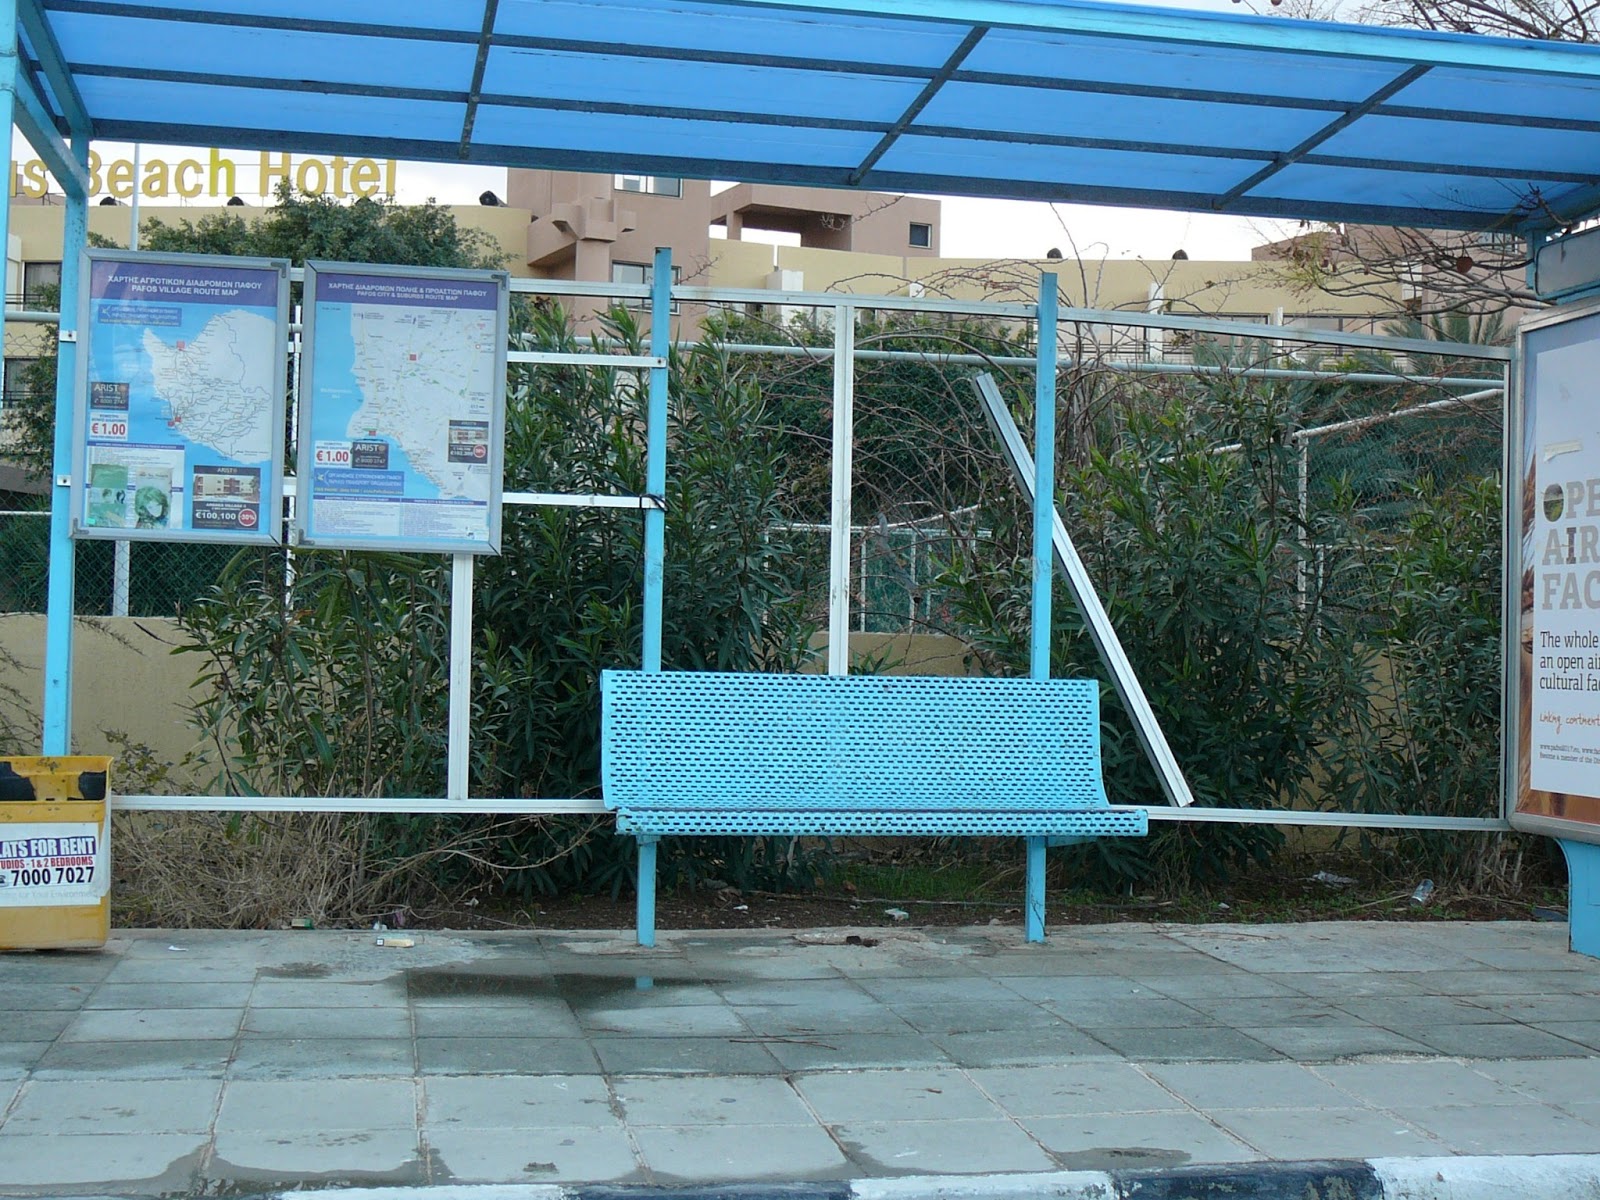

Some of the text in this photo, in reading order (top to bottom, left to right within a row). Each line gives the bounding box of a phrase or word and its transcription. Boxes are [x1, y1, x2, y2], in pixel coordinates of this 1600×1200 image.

[89, 147, 236, 199] Beach
[259, 151, 397, 198] Hotel
[131, 285, 239, 297] PAFOS VILLAGE ROUTE MAP
[356, 290, 377, 298] PAFOS
[396, 292, 425, 300] SUBURBS
[102, 423, 126, 435] 1.00
[326, 450, 349, 462] 1.00
[1542, 525, 1600, 566] AIR
[1542, 570, 1600, 610] FAC
[1540, 630, 1599, 648] The whole
[1540, 653, 1600, 674] an open ai
[1540, 672, 1600, 691] cultural fa
[0, 837, 95, 858] ATS FOR RENT
[0, 859, 25, 870] UDIOS
[37, 859, 43, 868] &
[44, 858, 49, 868] 2
[51, 856, 93, 867] BEDROOMS
[11, 866, 95, 886] 7000 7027
